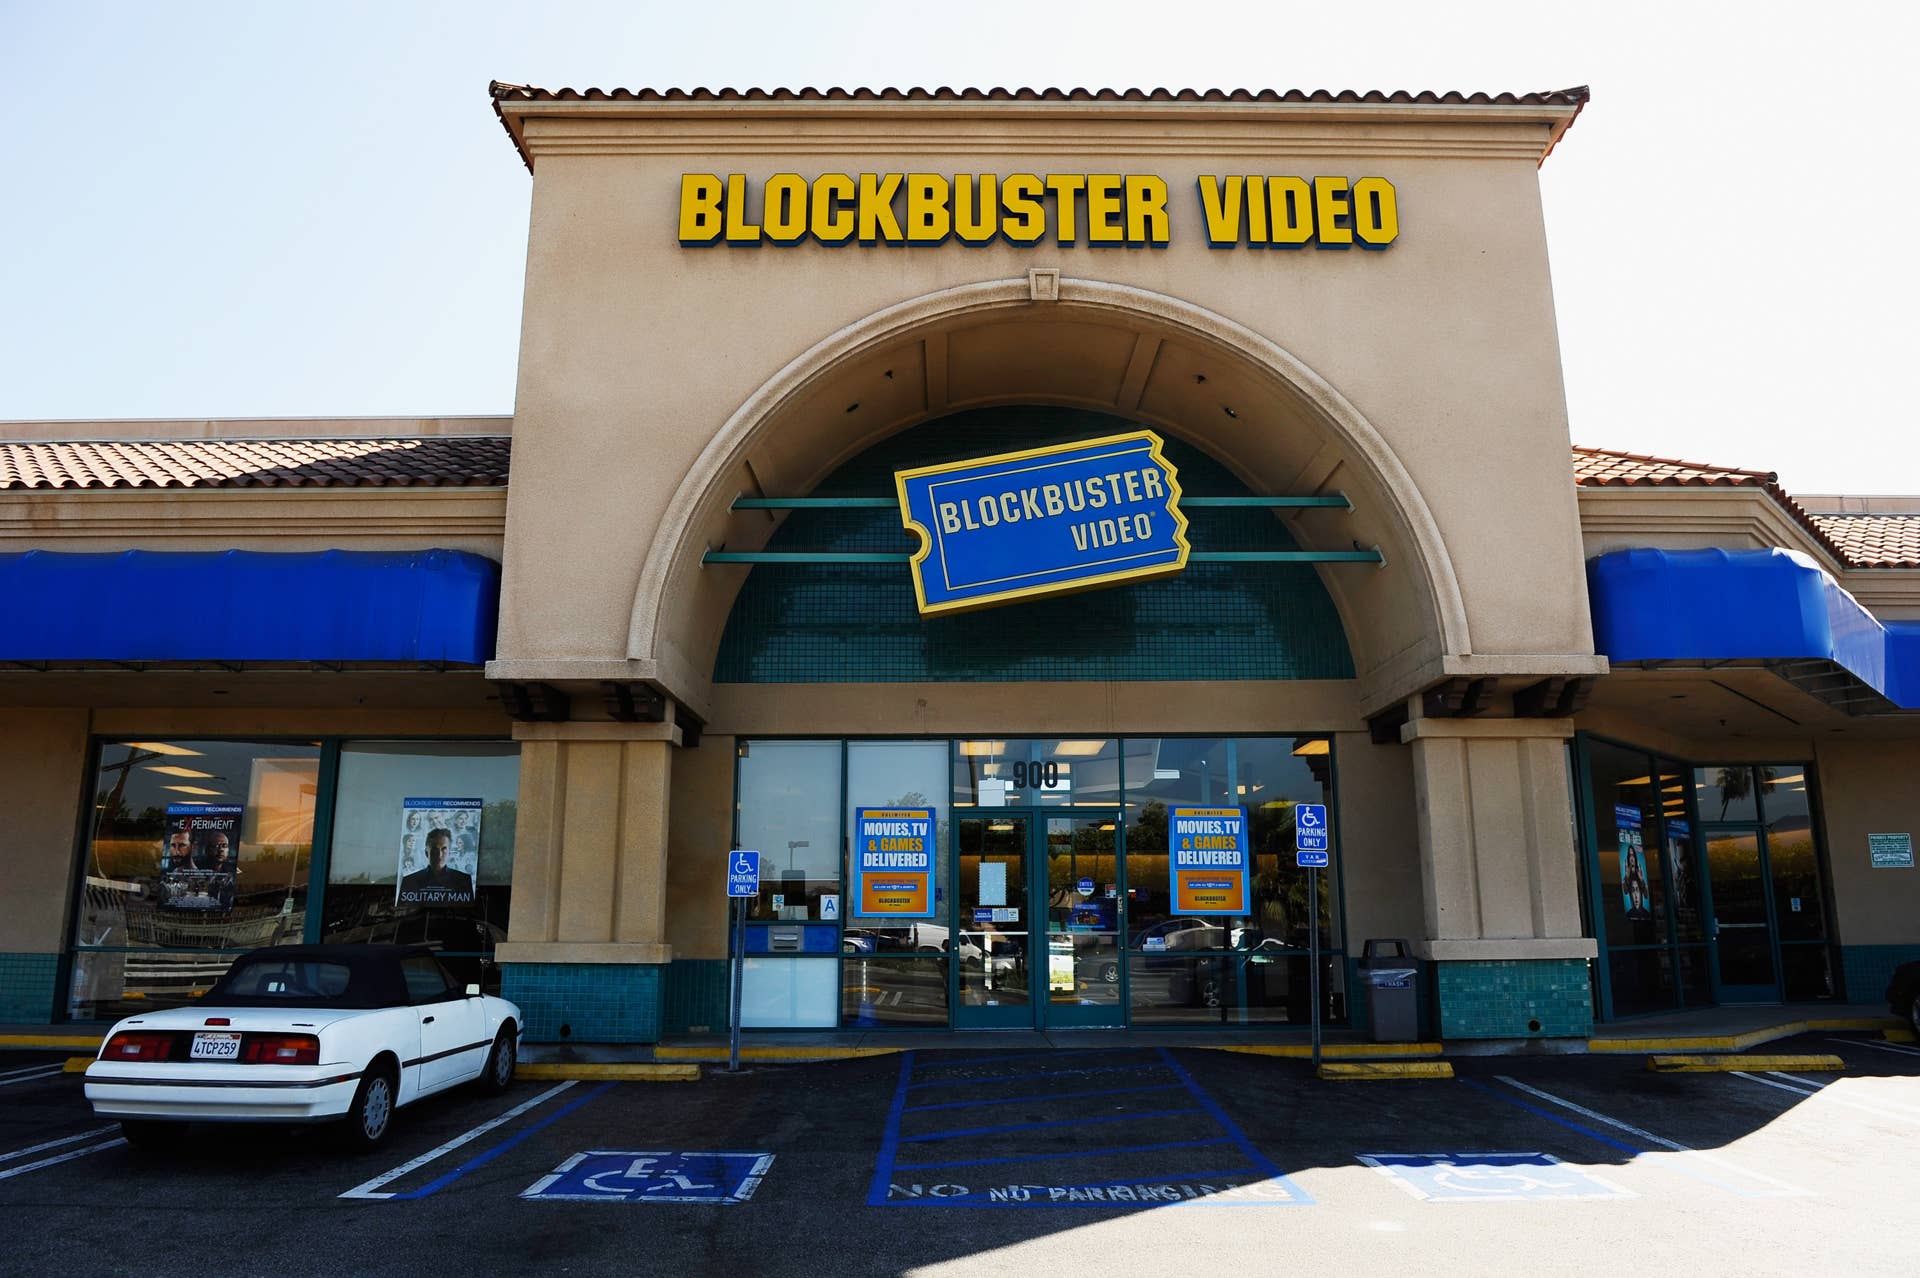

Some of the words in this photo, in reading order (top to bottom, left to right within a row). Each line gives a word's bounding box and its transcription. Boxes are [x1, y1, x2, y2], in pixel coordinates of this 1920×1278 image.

[678, 173, 1170, 248] BLOCKBUSTER
[1197, 174, 1400, 250] VIDEO
[939, 467, 1164, 535] BLOCKBUSTER
[1013, 760, 1058, 789] 900
[179, 818, 235, 833] EXPERIMENT
[864, 822, 911, 837] MOVIES,
[911, 822, 928, 836] TV
[1177, 820, 1224, 835] MOVIES,
[1223, 820, 1240, 834] TV
[1298, 827, 1326, 837] PARKING
[868, 839, 877, 852] &
[880, 837, 924, 852] GAMES
[1182, 837, 1191, 850] &
[1193, 835, 1237, 850] GAMES
[1303, 837, 1320, 847] ONLY
[863, 852, 928, 867] DELIVERED
[1177, 850, 1242, 865] DELIVERED
[730, 874, 757, 884] PARKING
[401, 891, 447, 902] SOLITARY
[448, 891, 471, 902] MAN
[735, 884, 751, 894] ONLY
[825, 899, 835, 912] A
[194, 1041, 237, 1055] 4TCP259
